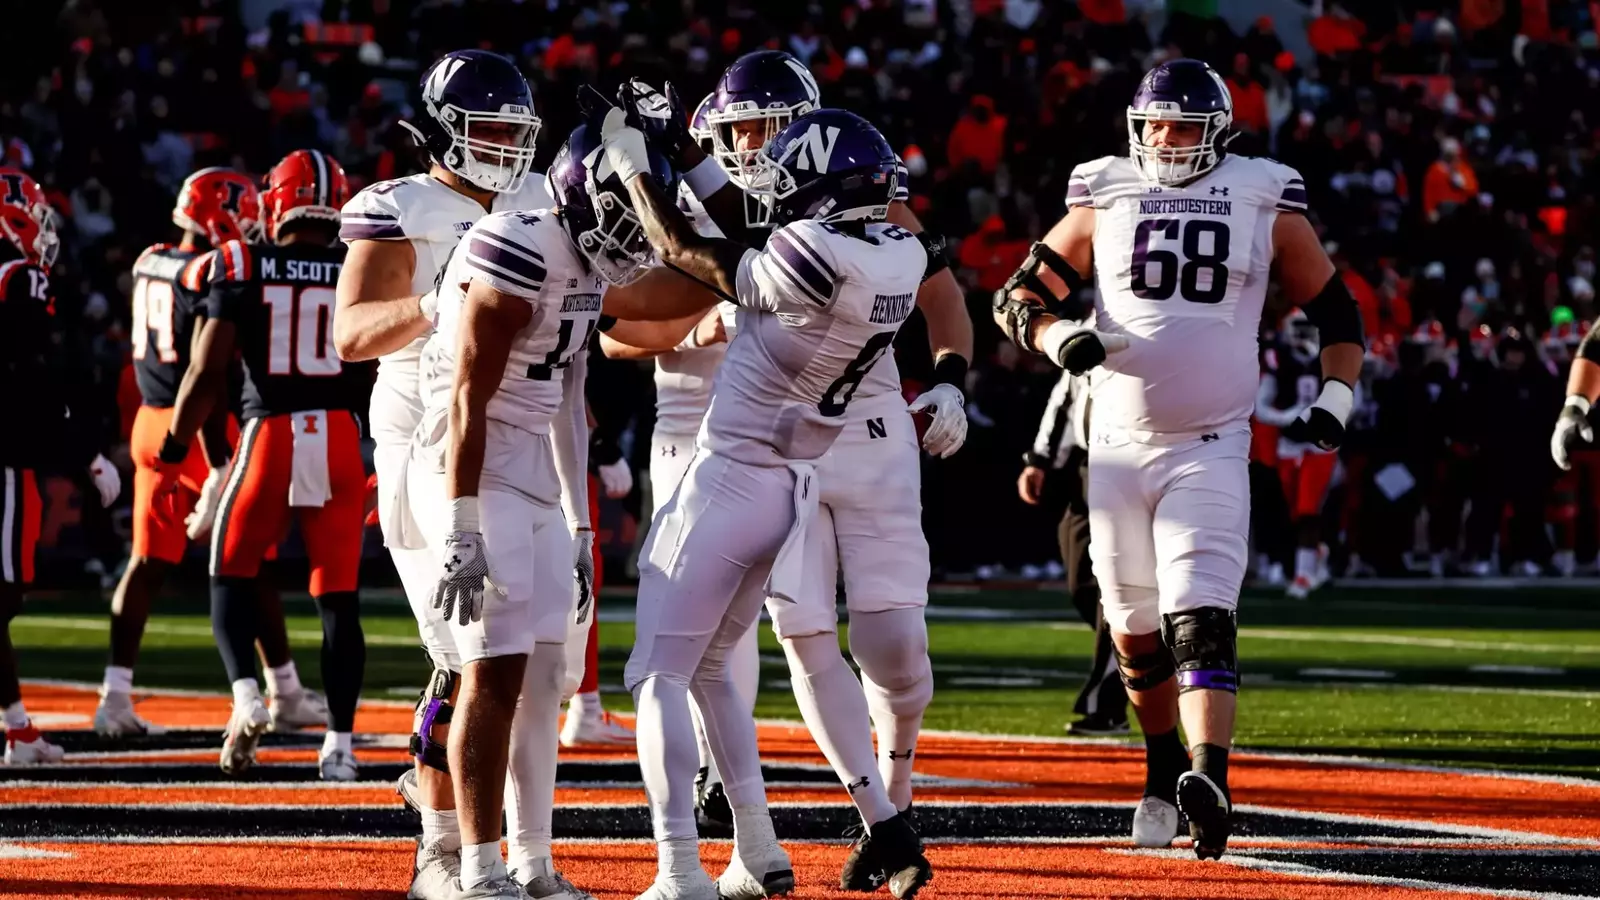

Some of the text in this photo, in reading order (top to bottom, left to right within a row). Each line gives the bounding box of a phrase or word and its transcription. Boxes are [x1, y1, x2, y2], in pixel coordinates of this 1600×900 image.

[797, 123, 841, 174] N
[1139, 198, 1232, 216] NORTHWESTERN
[28, 268, 49, 301] 12
[261, 257, 281, 279] M.
[1130, 219, 1231, 304] 68
[132, 276, 178, 363] 19
[263, 285, 342, 376] 10
[817, 331, 897, 417] 8
[866, 417, 887, 439] N
